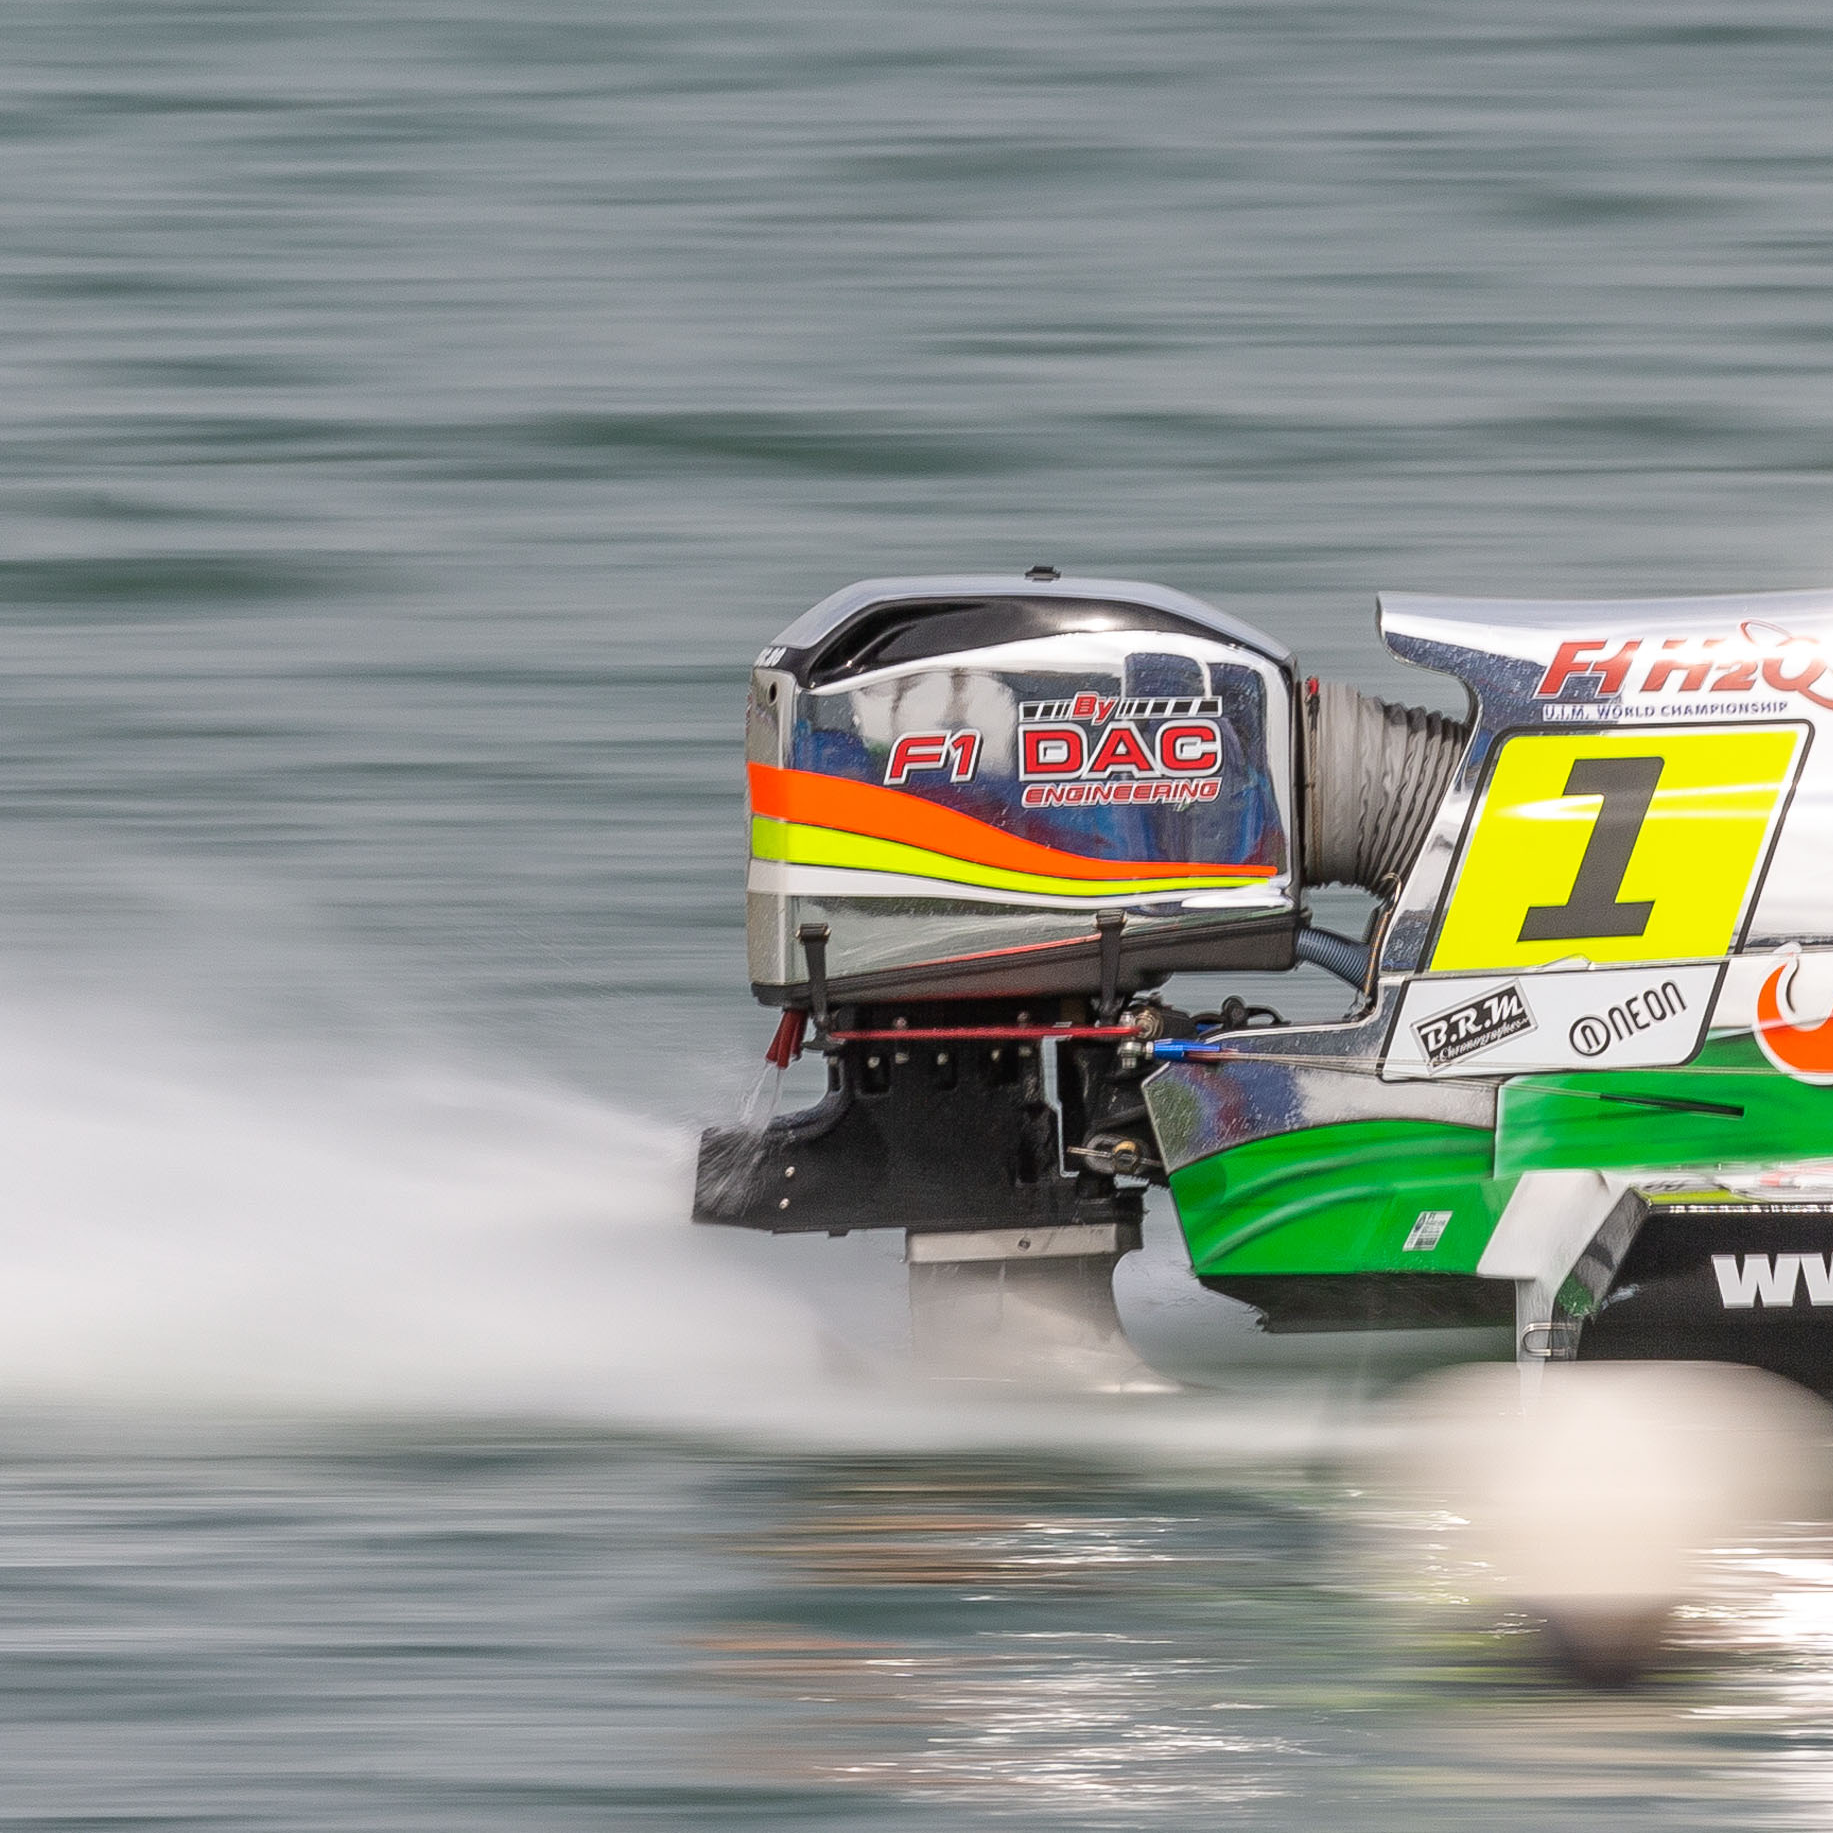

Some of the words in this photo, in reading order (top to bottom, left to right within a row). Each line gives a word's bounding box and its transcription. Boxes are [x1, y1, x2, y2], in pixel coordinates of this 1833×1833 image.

[1535, 637, 1645, 700] F1
[1070, 691, 1119, 726] By
[1597, 703, 1656, 720] WORLD
[1660, 701, 1789, 718] CHAMPIONSHIP
[883, 729, 985, 786] F1
[1018, 719, 1223, 782] DAC
[1022, 776, 1222, 808] ENGINEERING
[1516, 755, 1666, 943] 1
[1420, 994, 1526, 1053] B.R.M
